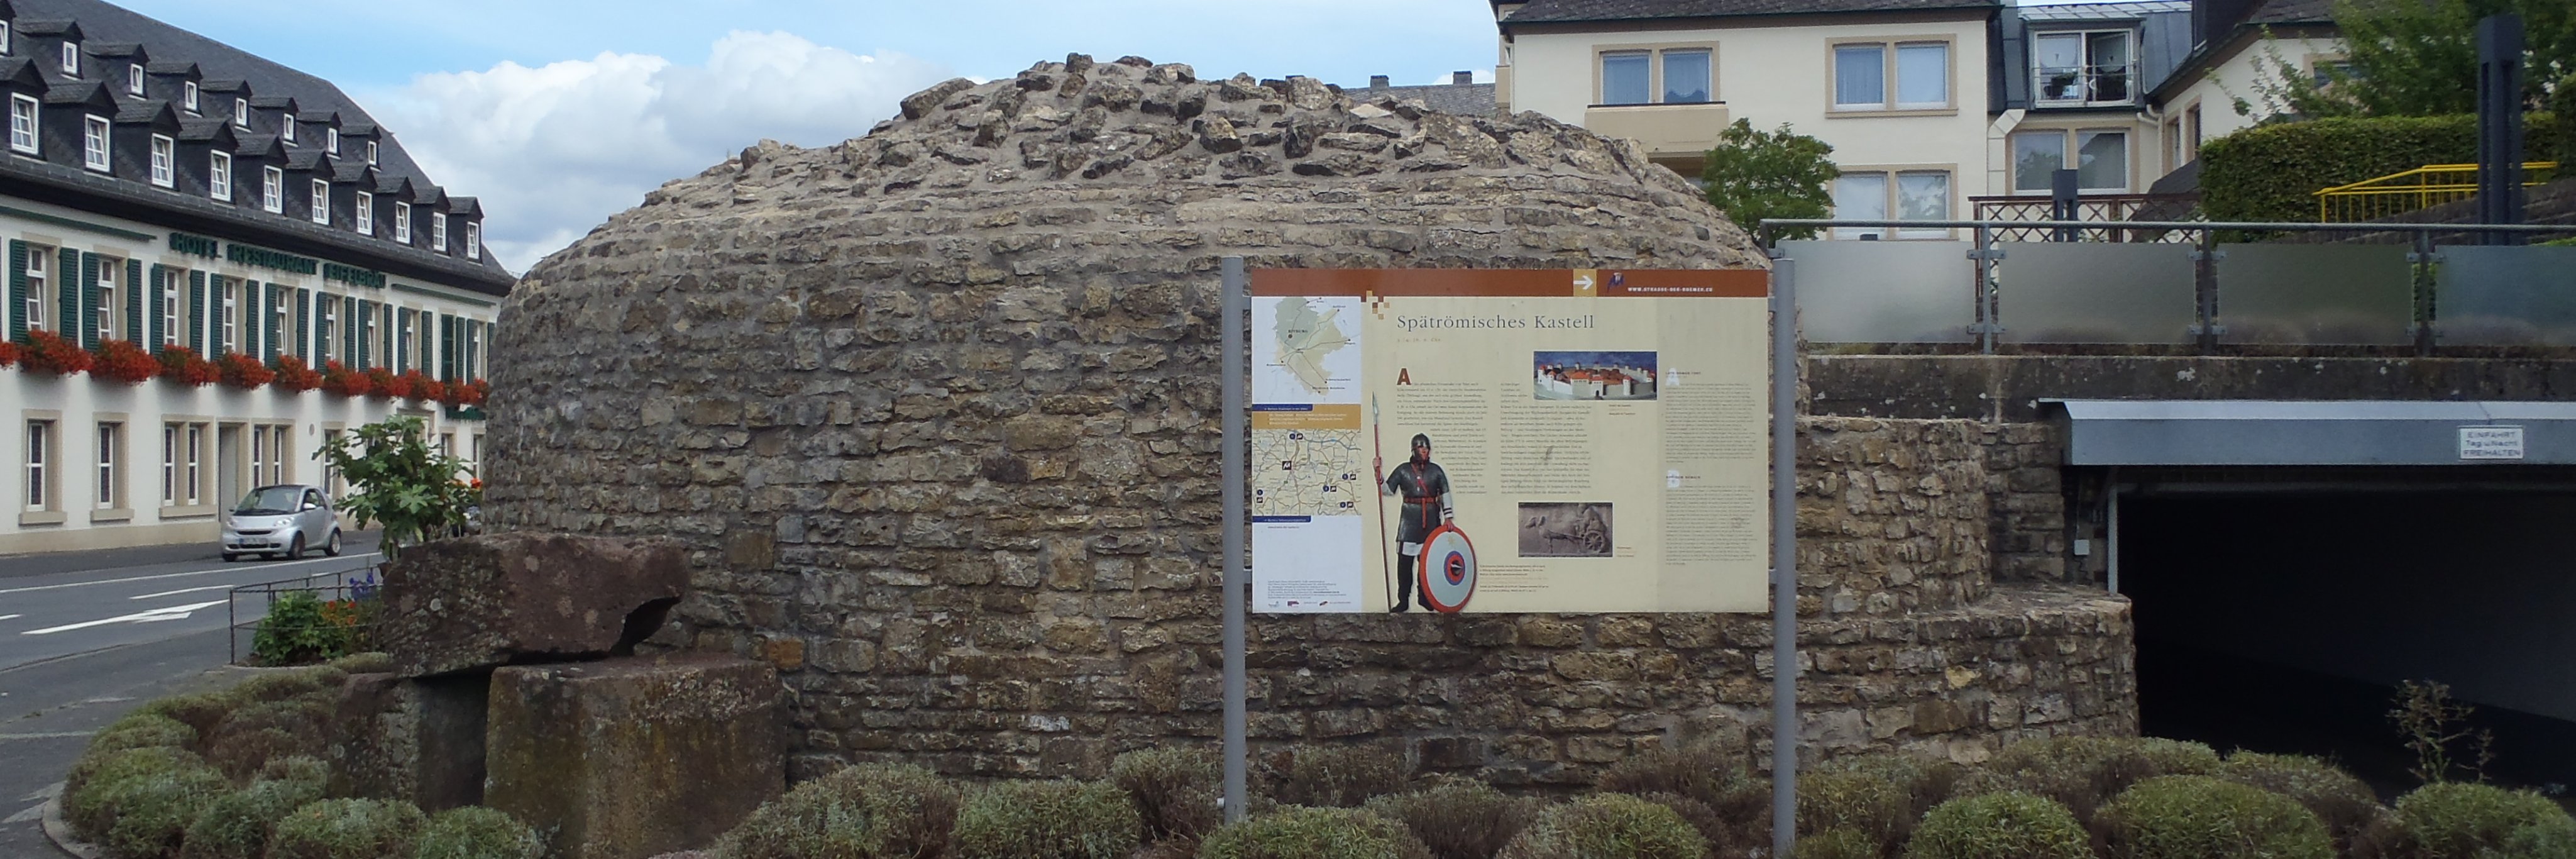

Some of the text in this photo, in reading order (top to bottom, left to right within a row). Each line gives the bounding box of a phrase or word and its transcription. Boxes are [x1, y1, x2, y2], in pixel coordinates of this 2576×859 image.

[169, 232, 222, 260] HOTEL
[227, 243, 319, 275] RESTAURANT
[1397, 314, 1595, 331] Spätrömisches Kastell
